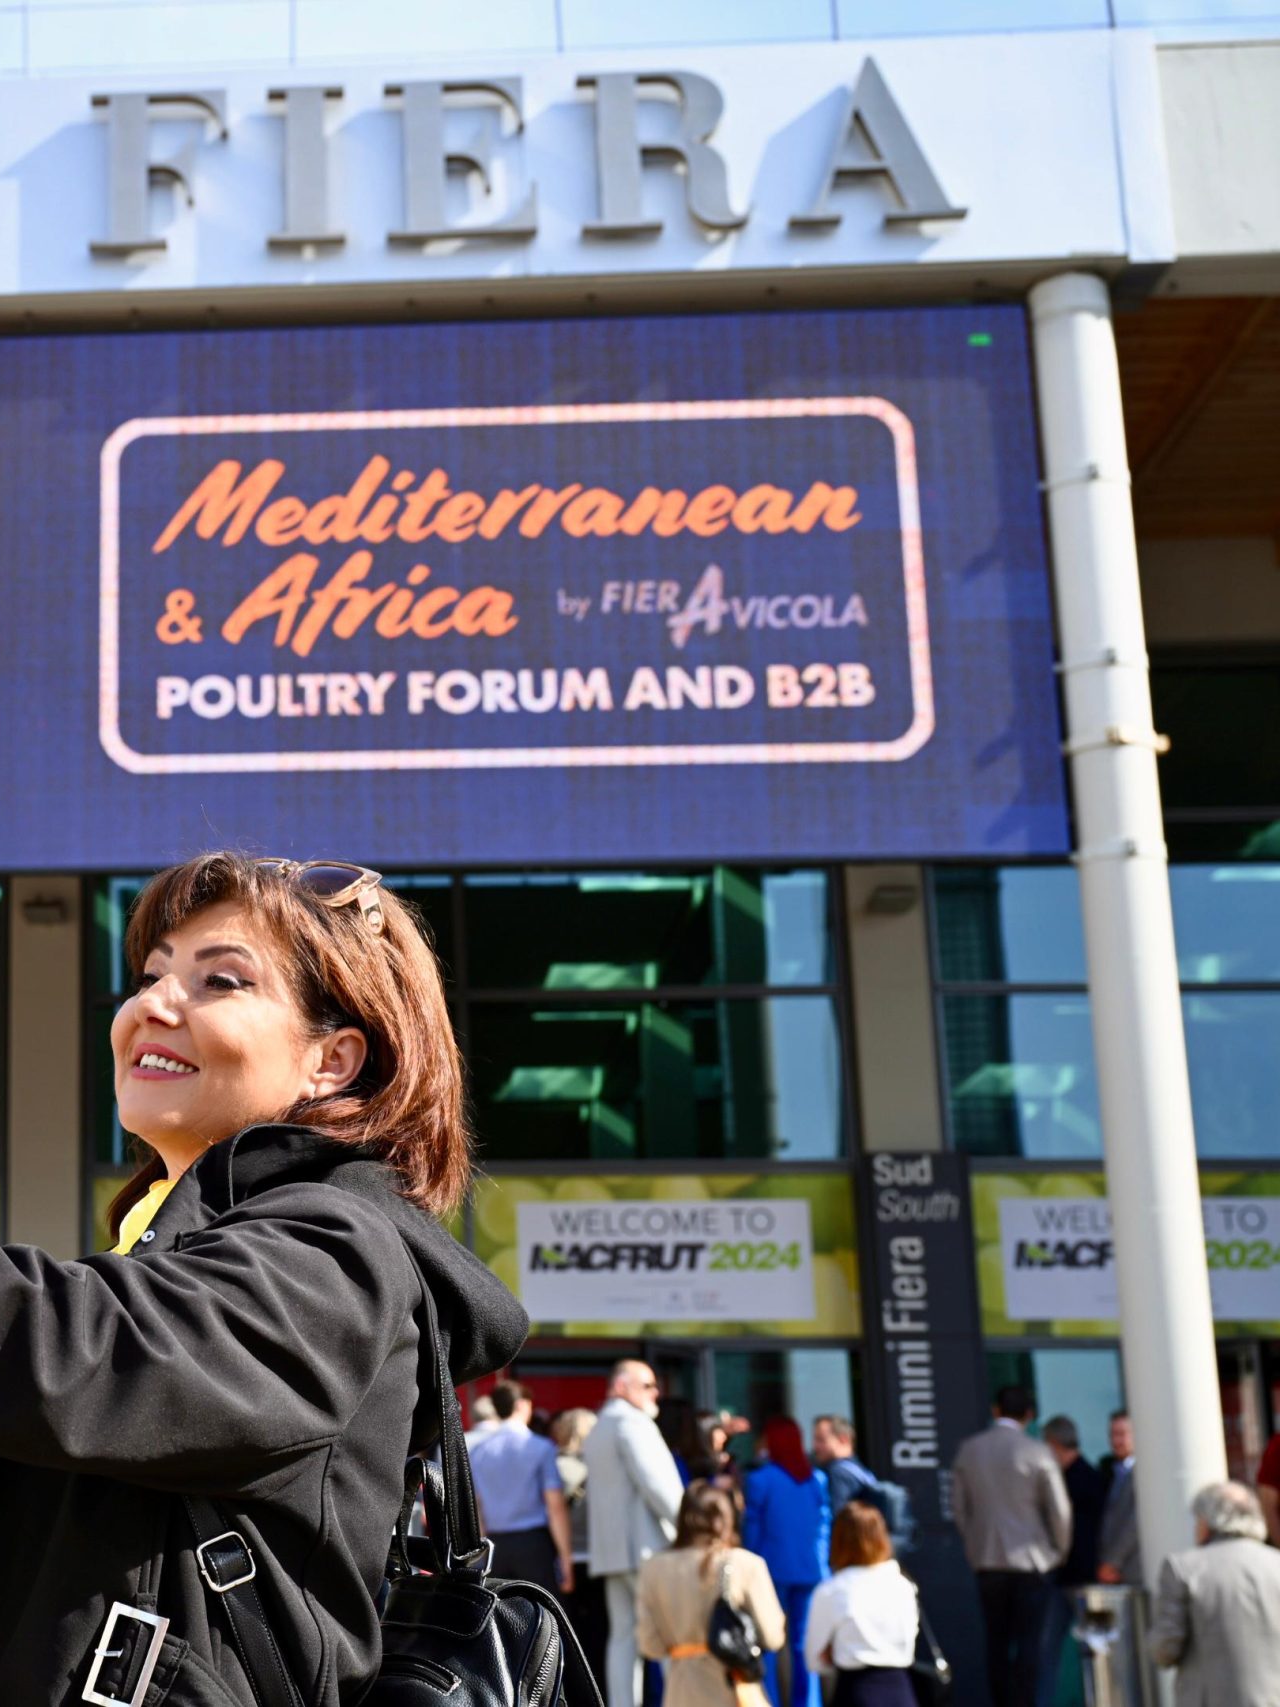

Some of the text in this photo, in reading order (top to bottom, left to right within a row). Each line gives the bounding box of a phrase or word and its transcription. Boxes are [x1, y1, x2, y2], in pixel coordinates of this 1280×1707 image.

[89, 54, 968, 259] FIERA
[153, 454, 862, 553] Mediterranean
[154, 588, 203, 645] &
[221, 549, 518, 657] Africa
[557, 588, 591, 621] by
[156, 662, 876, 719] POULTRY FORUM AND B2B
[873, 1153, 933, 1187] Sud
[549, 1206, 777, 1238] WELCOME TO
[876, 1189, 961, 1223] South
[1218, 1204, 1269, 1235] TO
[529, 1241, 802, 1272] MACFRUT 2024
[882, 1236, 940, 1468] Rimini Fiera
